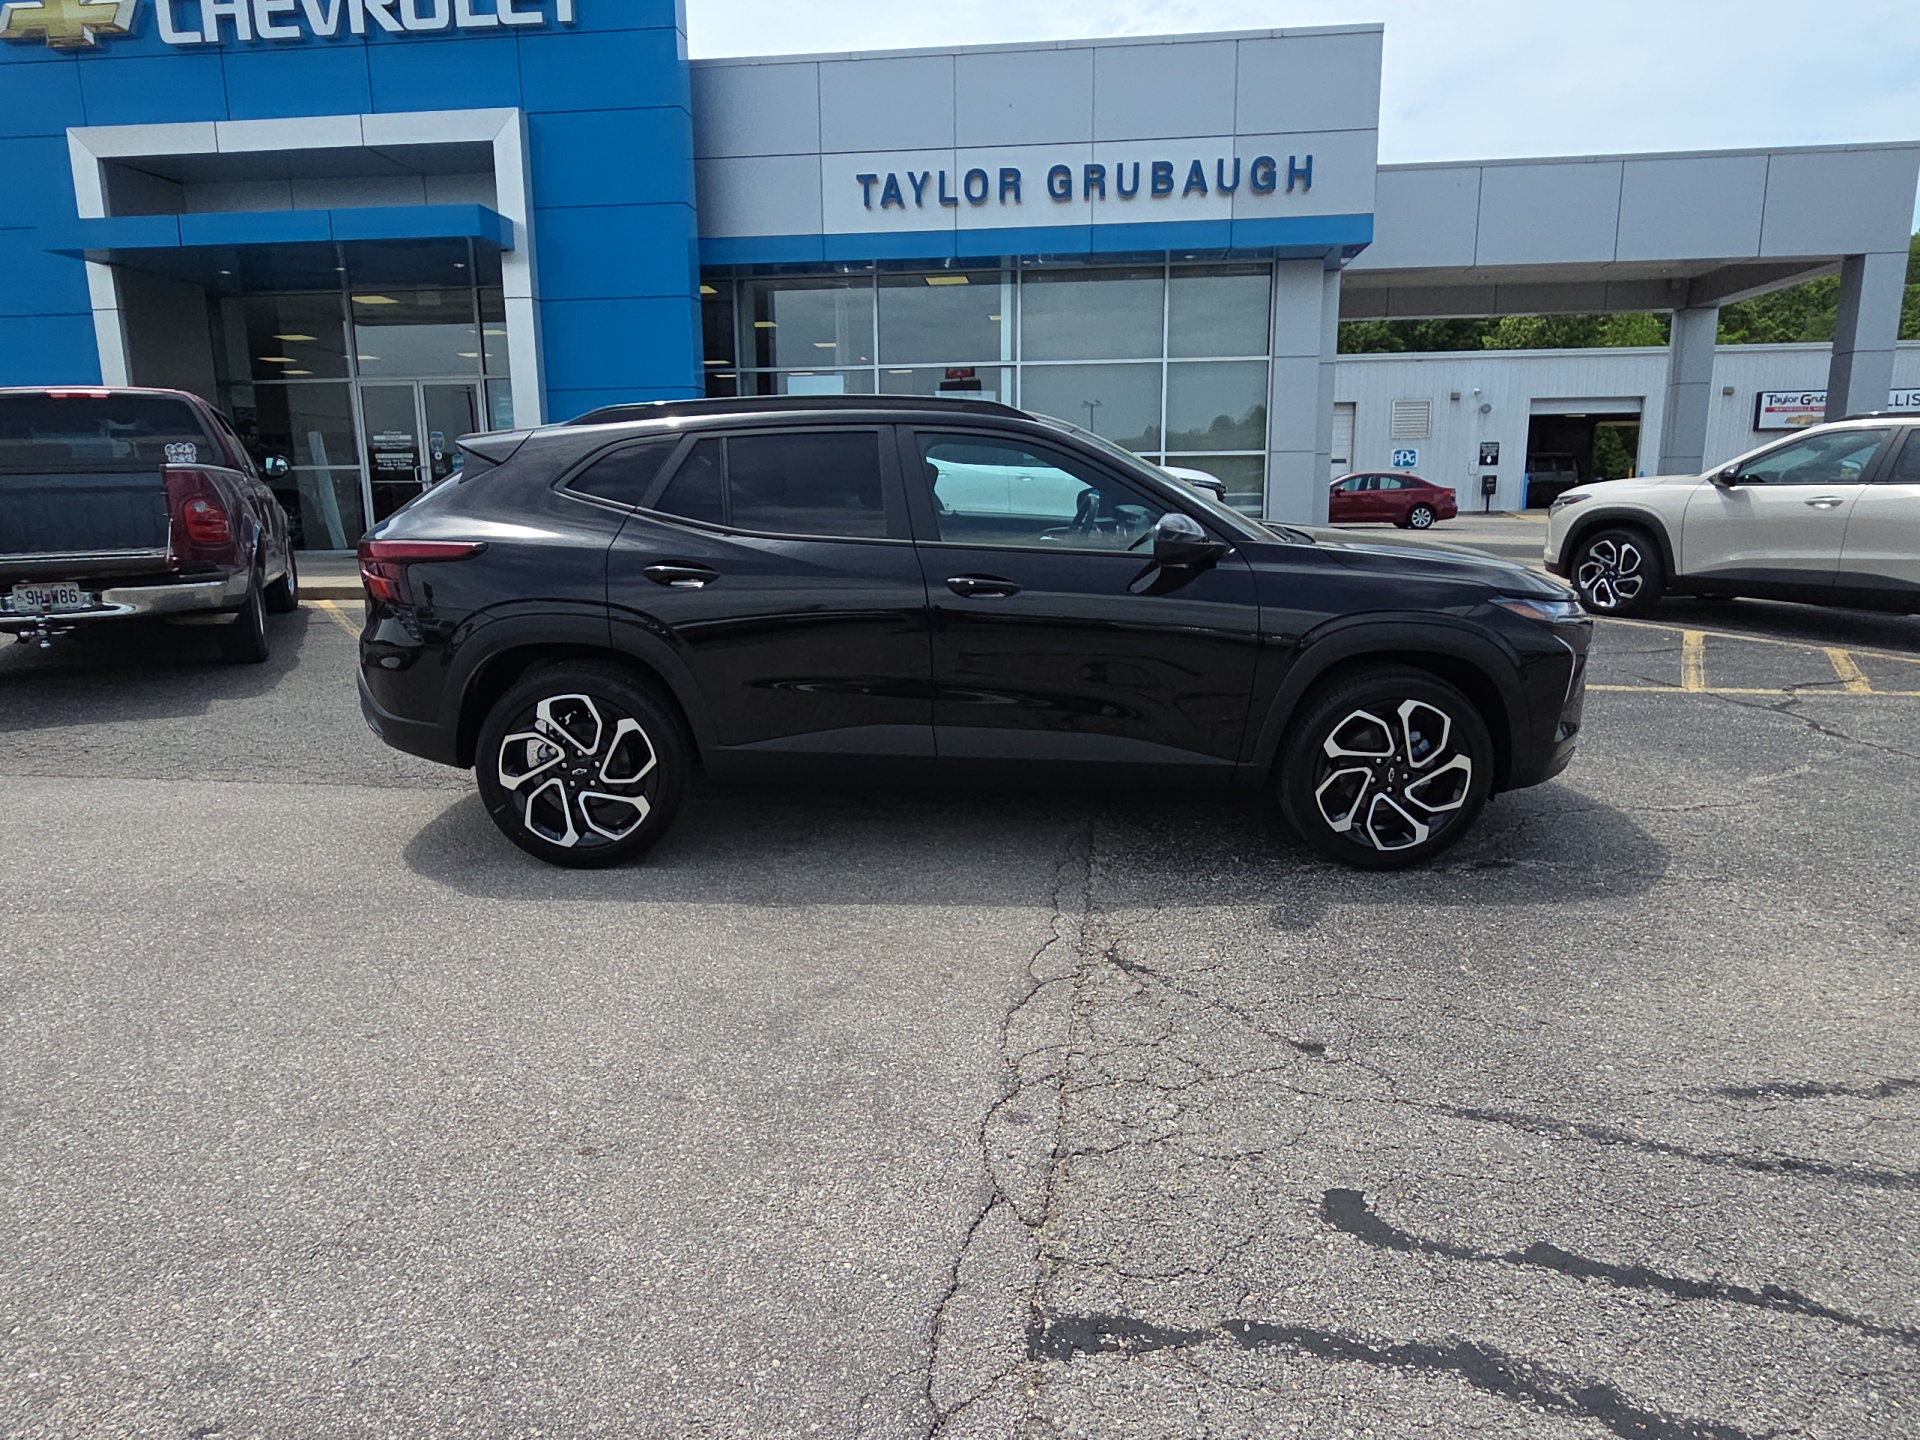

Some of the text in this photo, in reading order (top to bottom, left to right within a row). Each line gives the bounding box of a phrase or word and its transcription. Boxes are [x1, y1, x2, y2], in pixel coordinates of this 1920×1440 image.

[856, 154, 1314, 208] TAYLOR GRUBAUGH
[1766, 394, 1799, 406] Taylor
[1888, 393, 1920, 406] LIS
[1394, 451, 1415, 466] PPG
